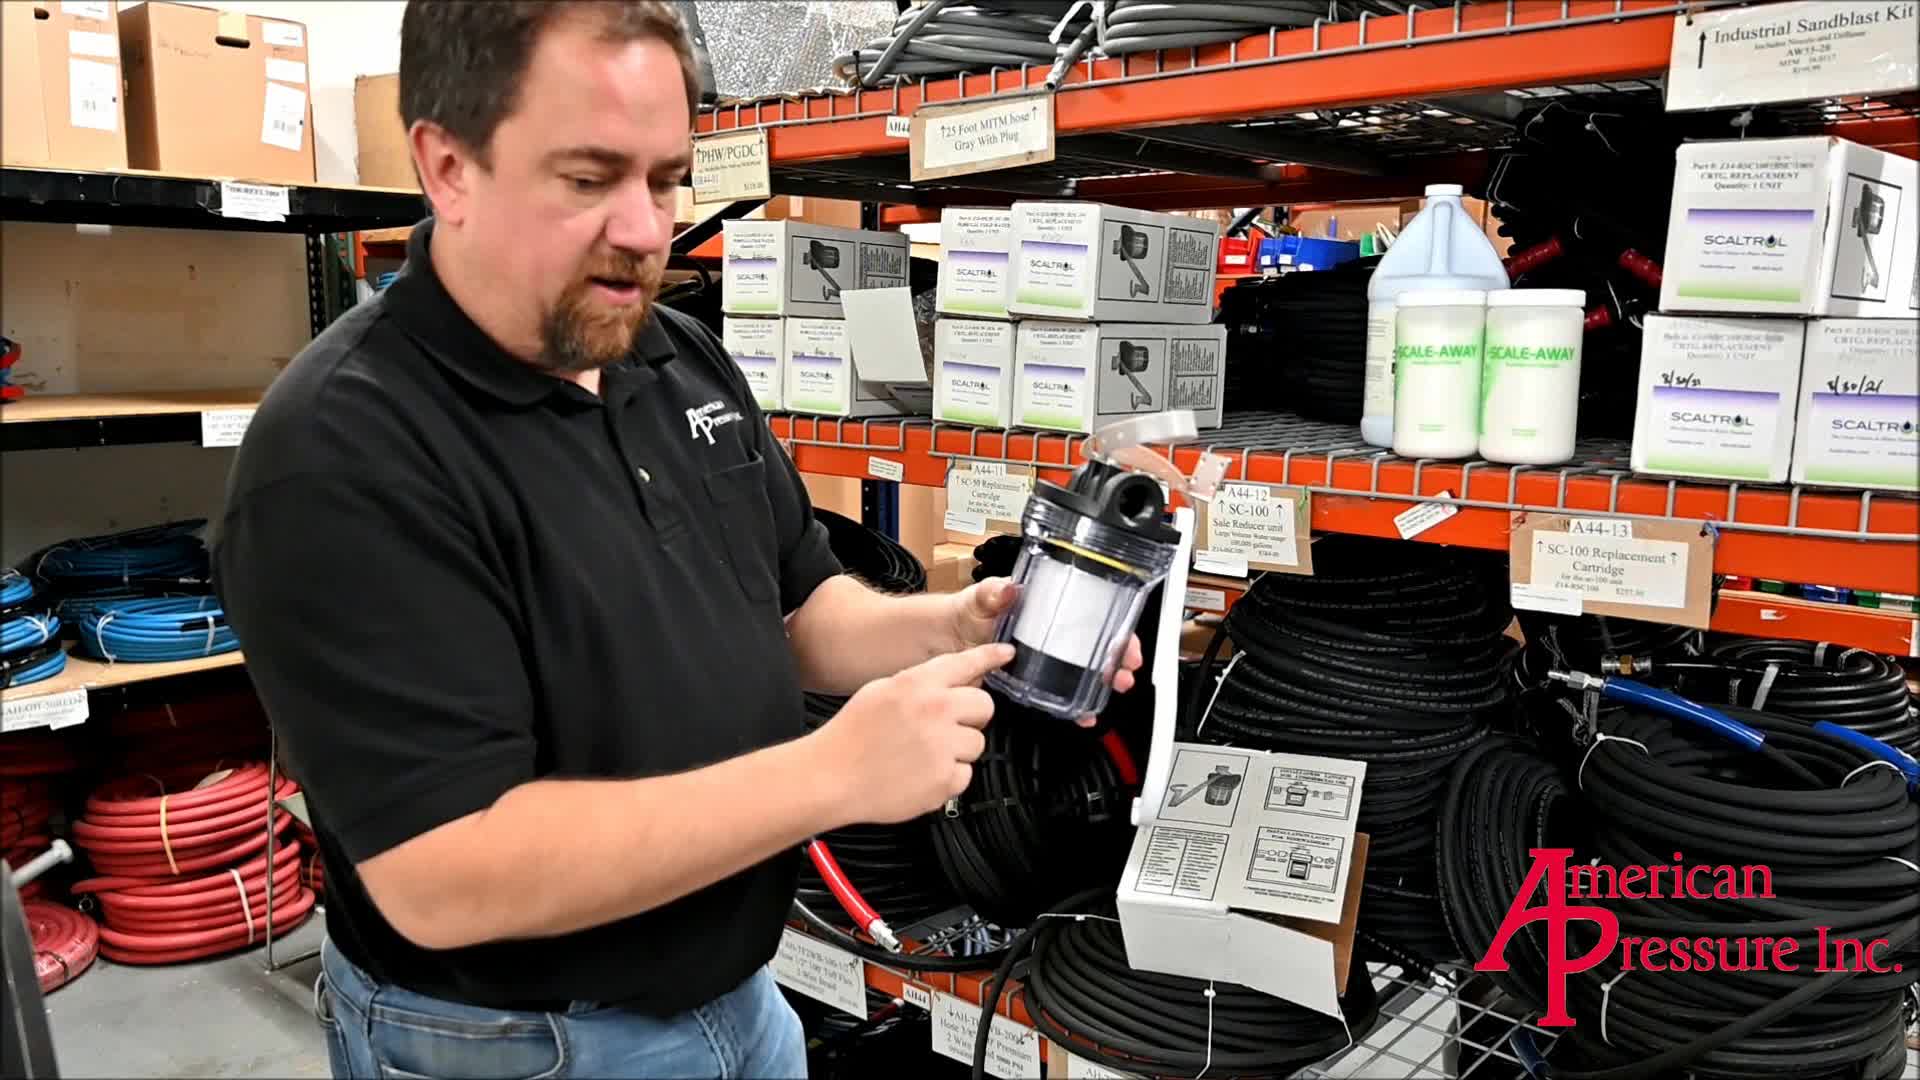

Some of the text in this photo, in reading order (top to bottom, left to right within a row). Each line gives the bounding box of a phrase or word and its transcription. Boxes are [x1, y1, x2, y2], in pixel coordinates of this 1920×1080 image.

[1714, 4, 1914, 44] Industrial Sandblast Kit
[946, 111, 1031, 138] 25 Foot MITM hose
[954, 130, 1019, 153] Gray With Plug
[702, 144, 756, 163] PHW/PGDC
[1704, 234, 1787, 249] SCALTROL
[1398, 344, 1478, 359] SCALE-AWAY
[1489, 345, 1576, 361] SCALE-AWAY
[1671, 411, 1754, 427] SCALTROL
[974, 464, 1004, 477] A44-11
[1228, 487, 1268, 502] A44-12
[1229, 503, 1270, 518] SC-100
[1232, 519, 1265, 531] Reducer
[1572, 520, 1628, 538] A44-13
[1547, 543, 1667, 565] SC-100 Replacement
[1572, 562, 1625, 577] Cartridge
[905, 989, 927, 1004] AH44
